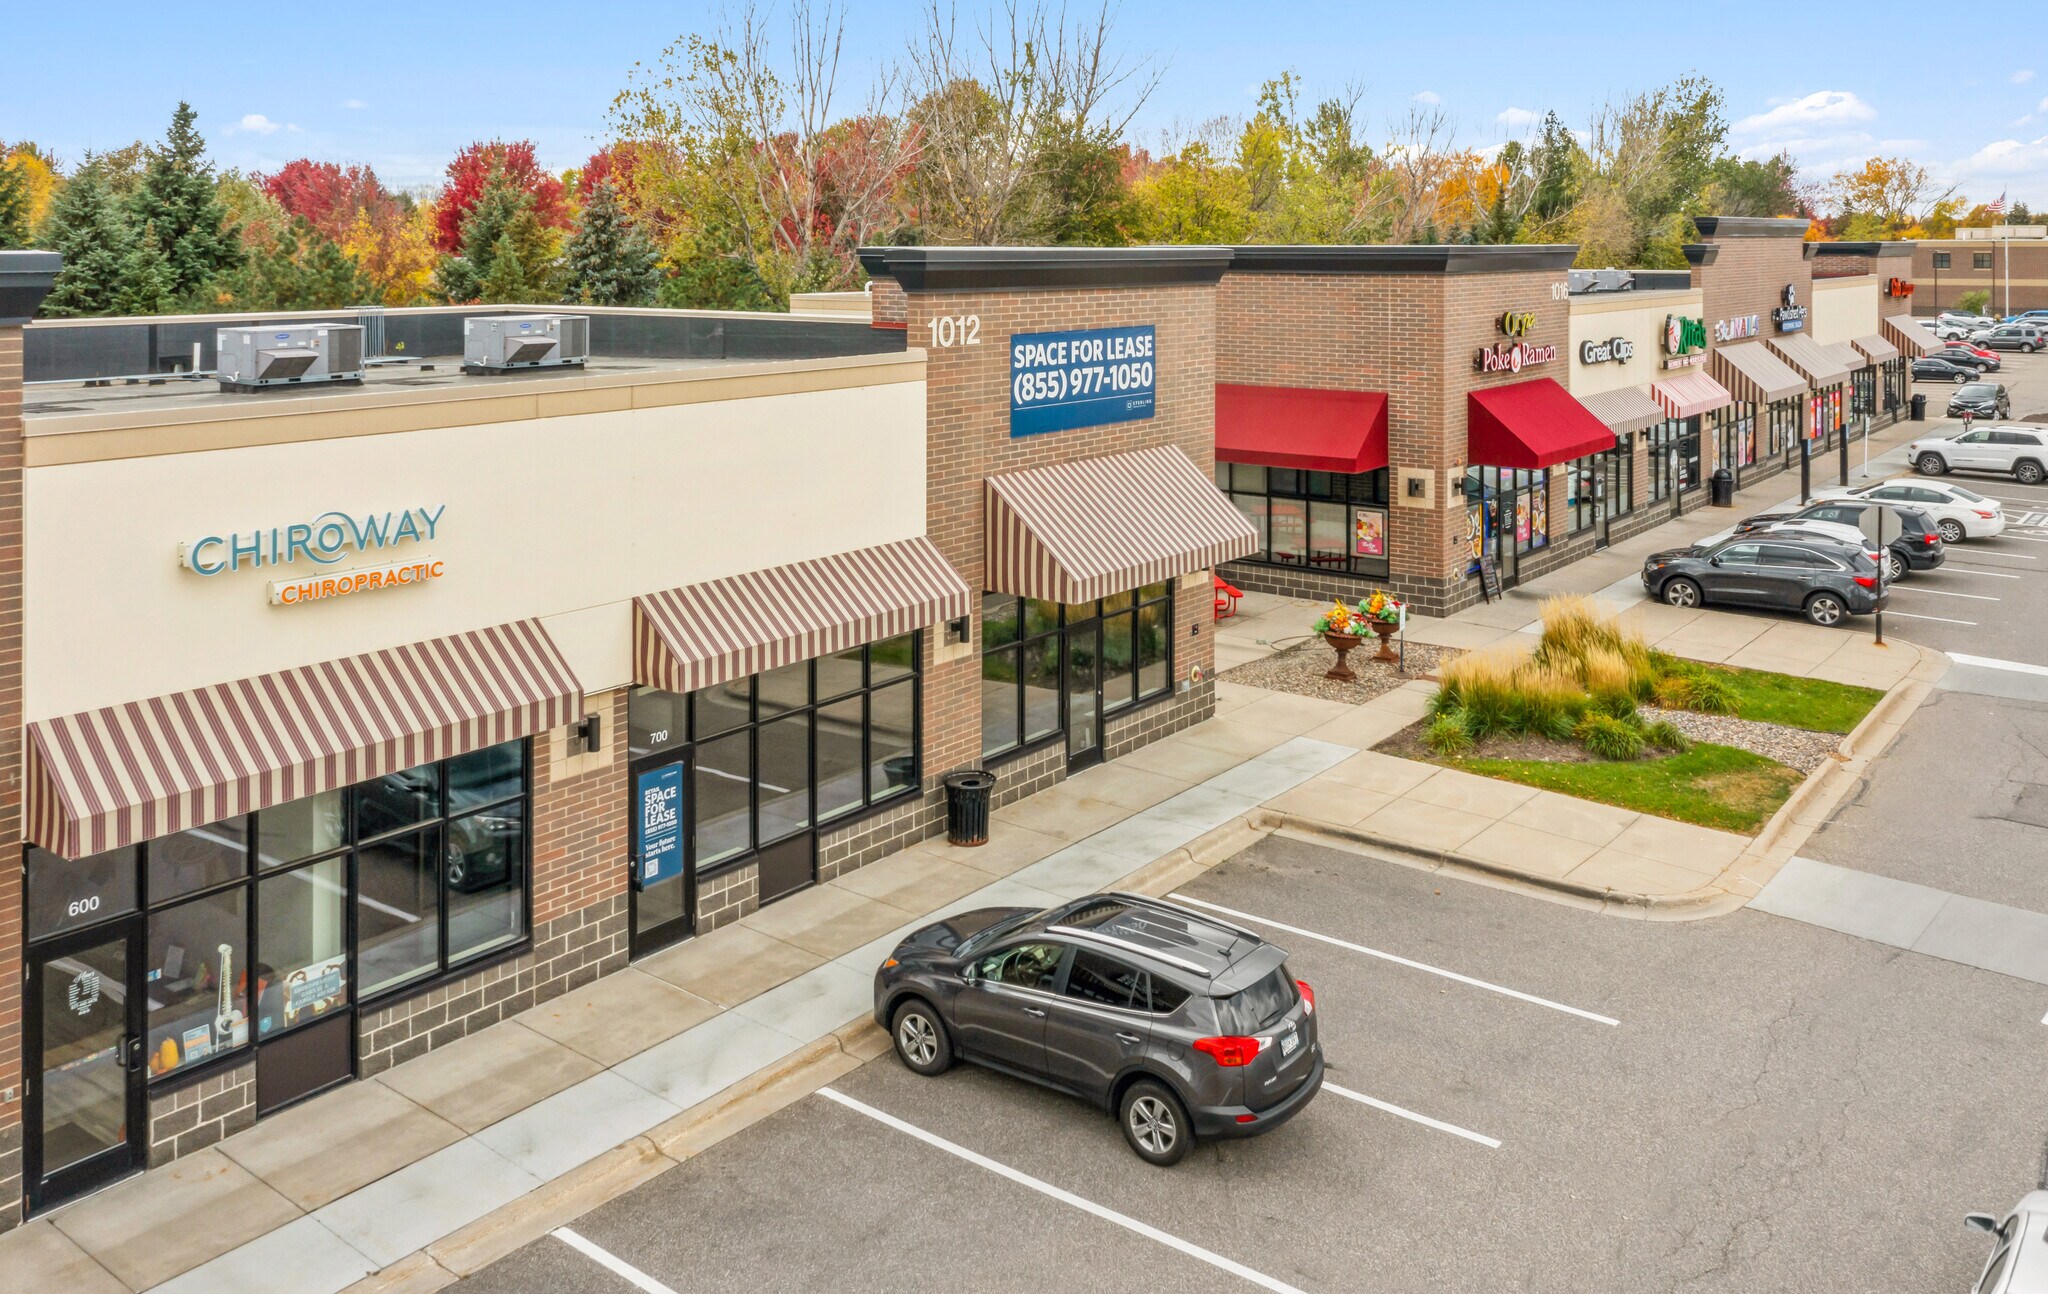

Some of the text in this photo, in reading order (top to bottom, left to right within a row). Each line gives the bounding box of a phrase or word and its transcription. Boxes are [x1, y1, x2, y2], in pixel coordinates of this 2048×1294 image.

[1550, 282, 1568, 300] 1016
[927, 314, 981, 348] 1012
[1014, 335, 1153, 368] SPACE FOR LEASE
[1483, 342, 1557, 373] Poke Ramen
[1584, 338, 1634, 364] Great Clips
[1013, 361, 1153, 405] (855) 977-1050
[190, 504, 446, 576] CHIROWAY
[281, 561, 444, 604] CHIROPRACTIC
[650, 729, 668, 744] 700
[645, 786, 660, 796] RETAIL
[645, 786, 677, 806] SPACE
[645, 801, 665, 818] FOR
[645, 807, 676, 829] LEASE
[645, 836, 676, 851] Your future
[645, 849, 661, 859] starts
[68, 896, 100, 916] 600
